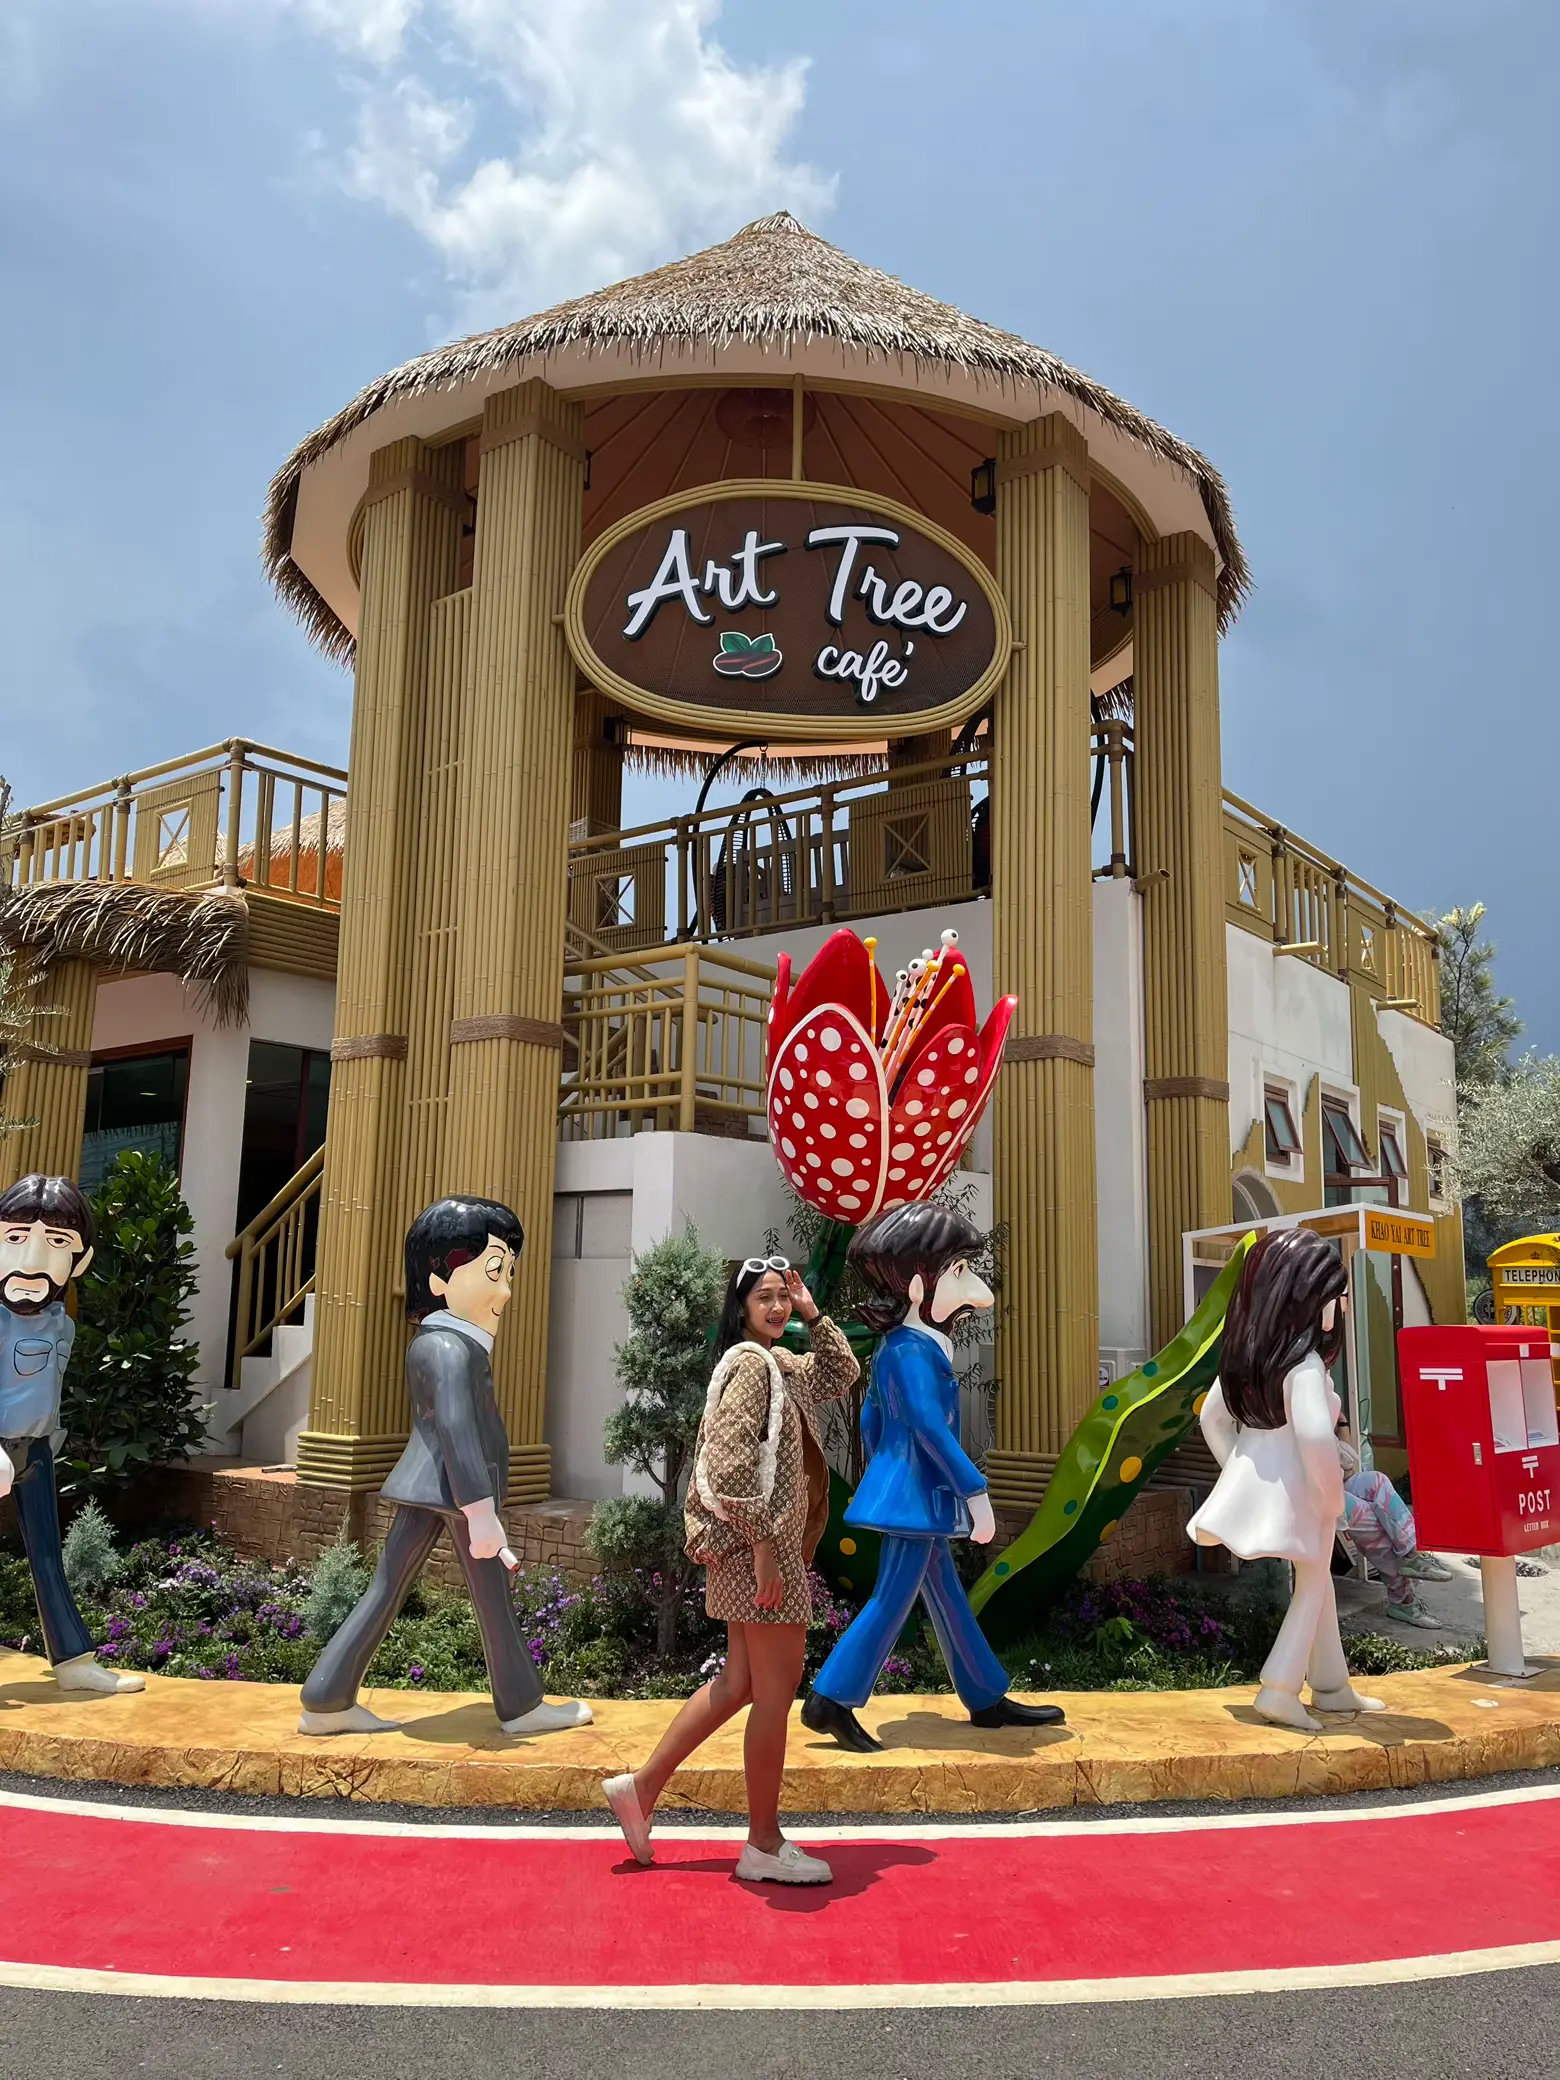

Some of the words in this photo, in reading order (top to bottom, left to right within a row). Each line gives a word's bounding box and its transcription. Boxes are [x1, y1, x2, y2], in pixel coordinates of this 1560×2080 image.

[622, 529, 783, 636] Art
[808, 526, 967, 634] Tree
[1371, 1220, 1390, 1241] KHAO
[1404, 1227, 1415, 1246] ART
[1416, 1228, 1430, 1247] TREE
[1519, 1489, 1550, 1515] POST
